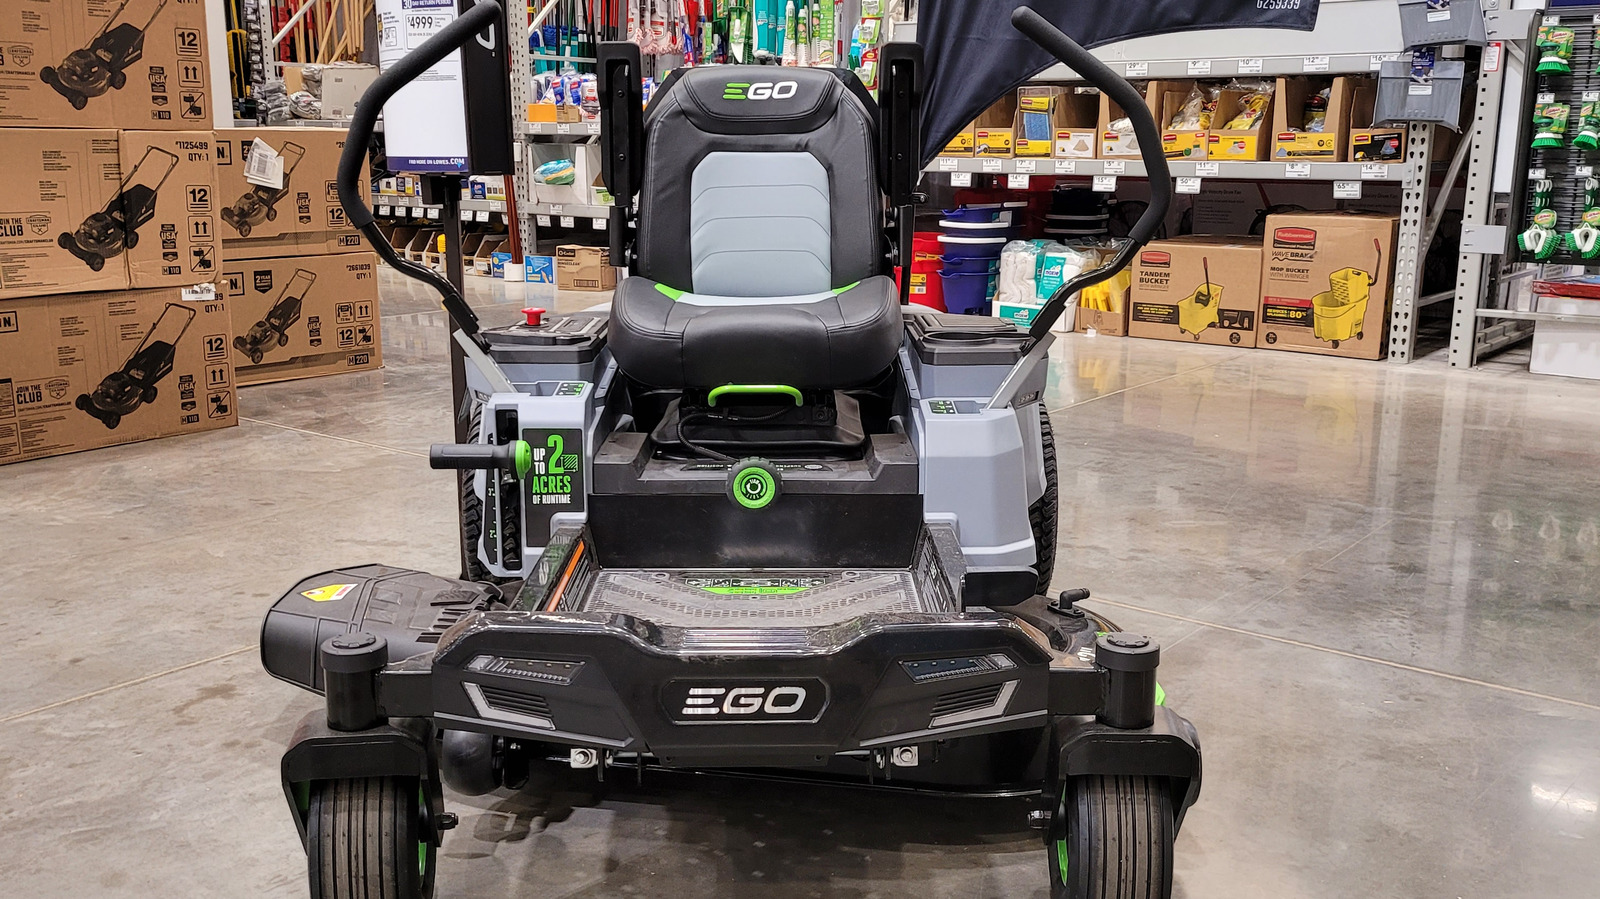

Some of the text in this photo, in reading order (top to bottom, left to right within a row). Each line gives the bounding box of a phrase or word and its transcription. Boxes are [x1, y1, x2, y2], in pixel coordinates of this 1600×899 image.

[178, 32, 198, 47] 12
[722, 81, 798, 100] EGO
[188, 153, 204, 161] QTY:
[189, 189, 208, 202] 12
[329, 208, 344, 219] 12
[0, 225, 23, 236] CLUB
[205, 305, 220, 313] QTY:
[340, 329, 353, 340] 12
[206, 337, 224, 352] 12
[16, 391, 42, 404] CLUB
[534, 448, 545, 461] UP
[547, 434, 564, 474] 2
[534, 462, 545, 474] TO
[532, 476, 571, 493] ACRES
[533, 494, 571, 504] OF RUNTIME
[681, 686, 807, 714] EGO
